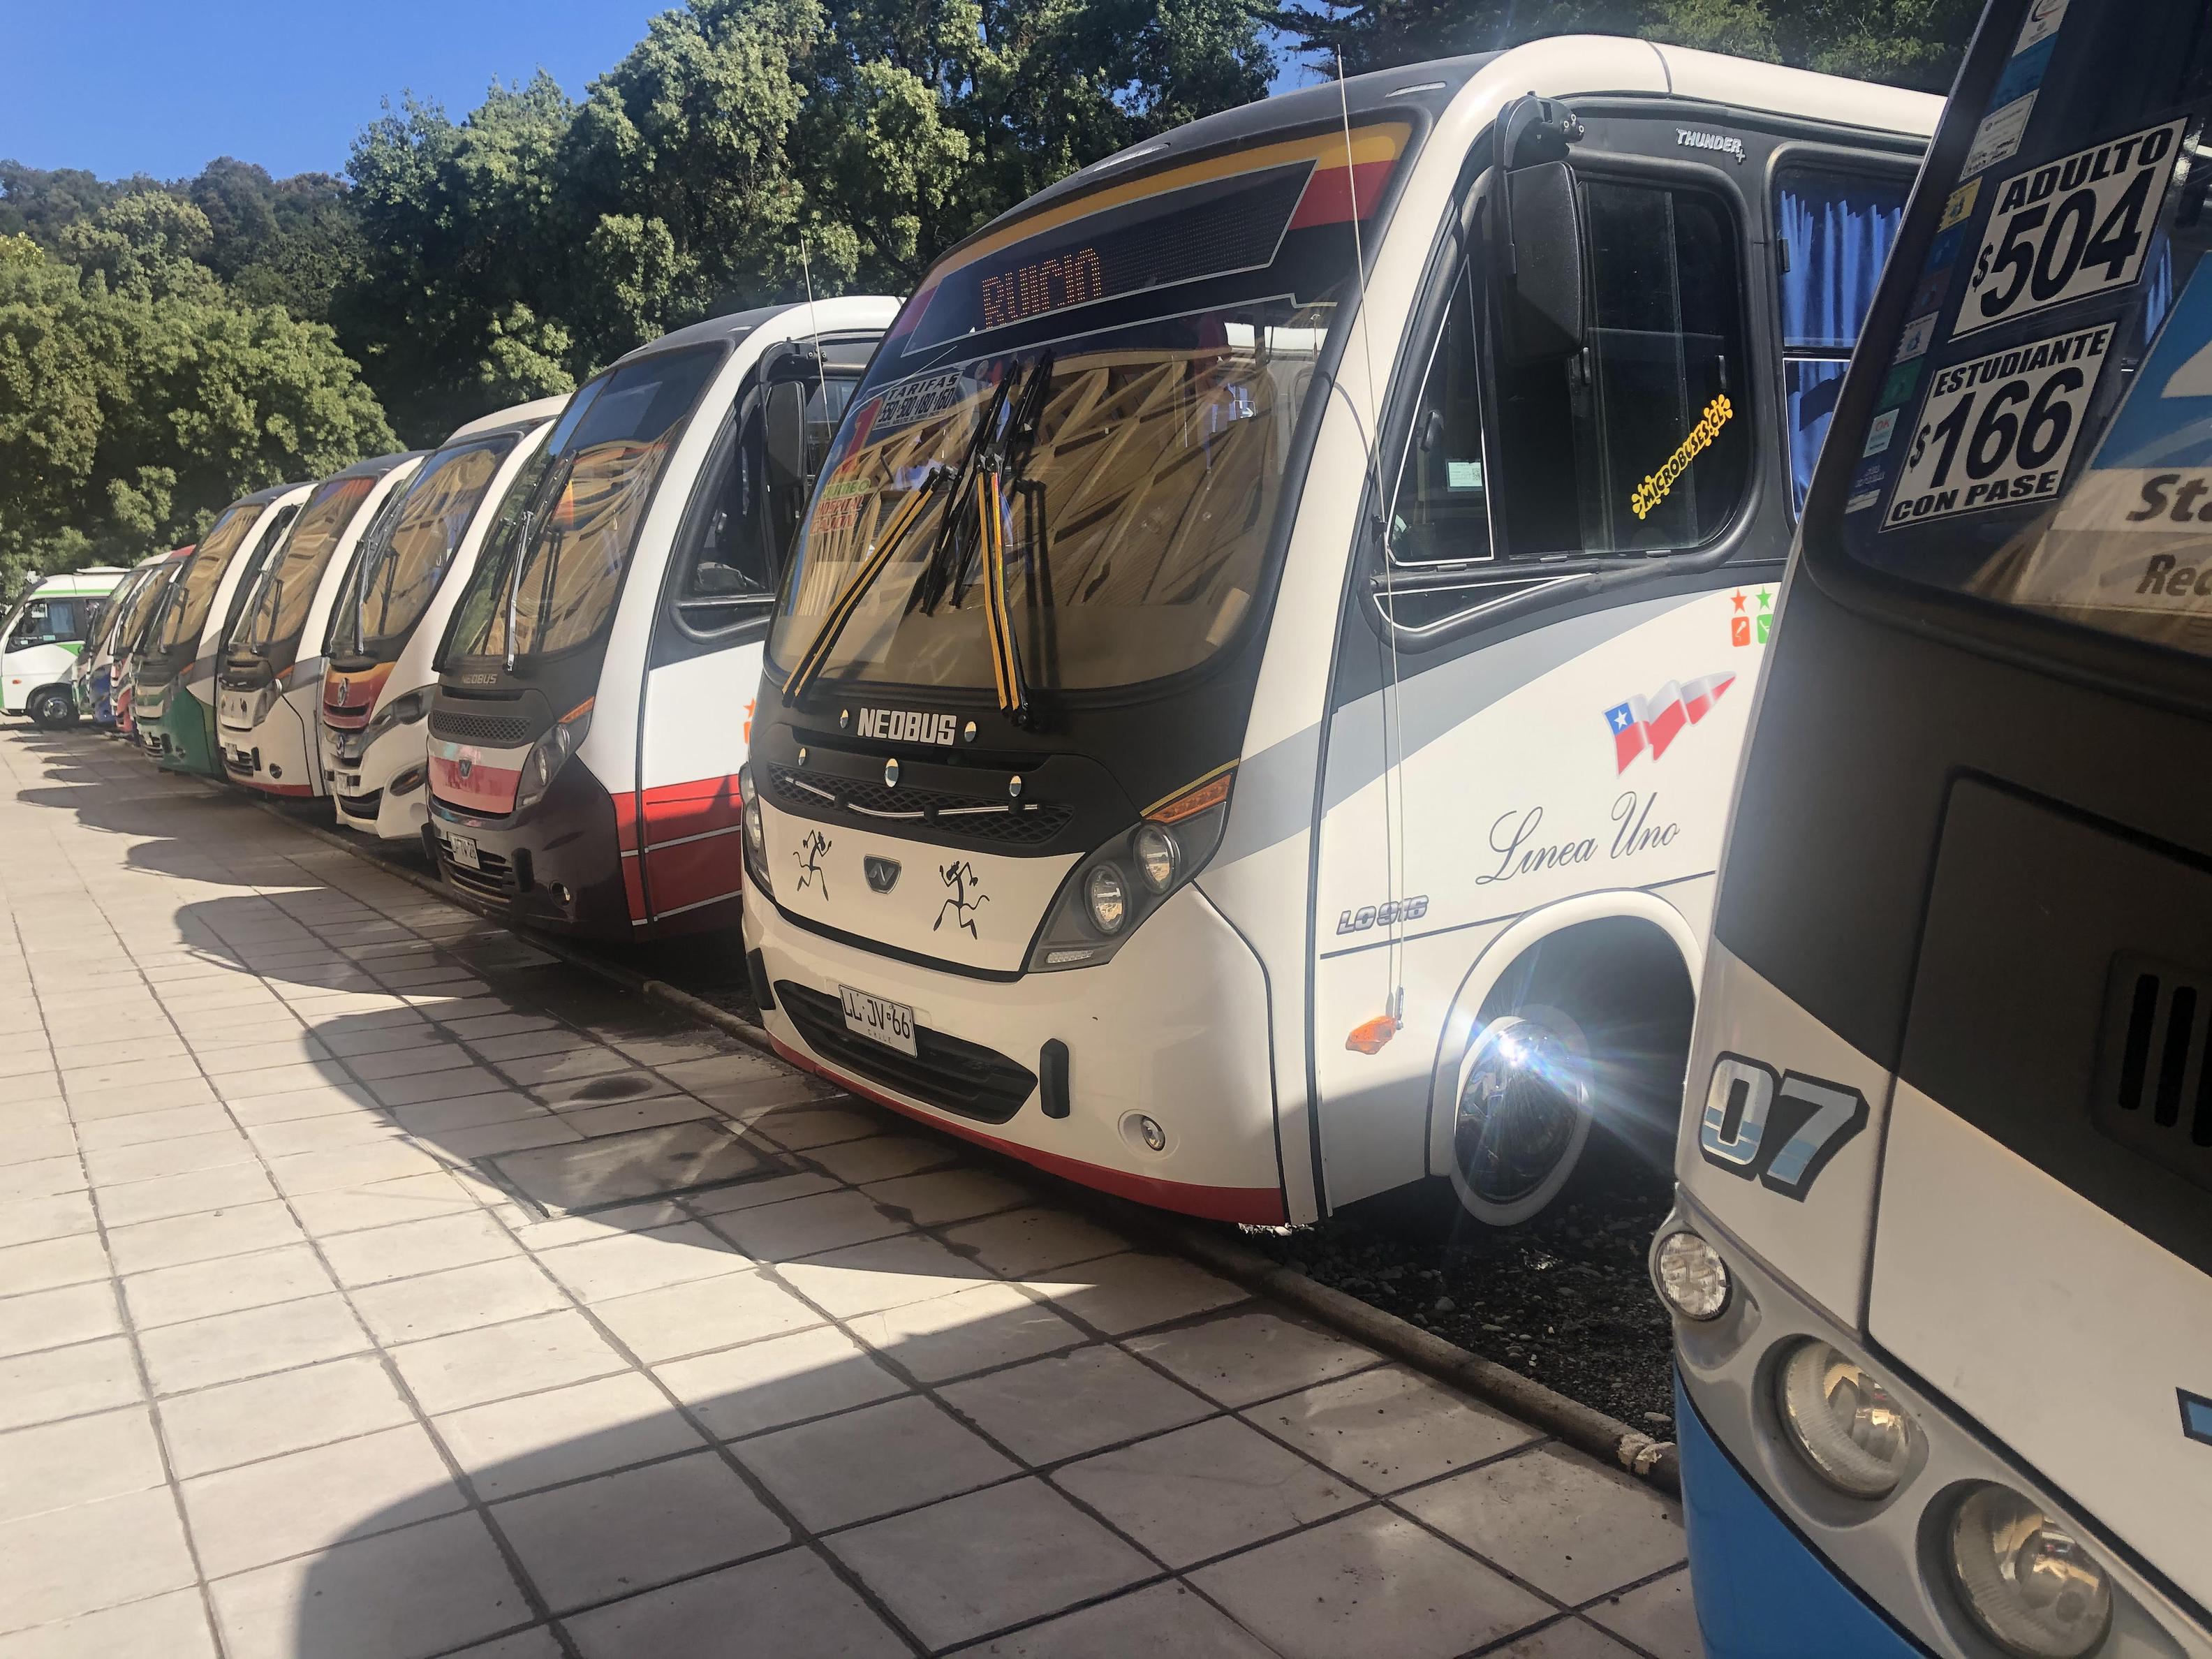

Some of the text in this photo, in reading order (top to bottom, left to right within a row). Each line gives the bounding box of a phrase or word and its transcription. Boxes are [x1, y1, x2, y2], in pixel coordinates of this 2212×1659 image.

[1998, 128, 2174, 216] ADULTO
[1972, 166, 2142, 318] $504
[889, 374, 960, 400] TARIFAS
[1933, 328, 2111, 399] ESTUDIANTE
[840, 397, 884, 475] 1
[1909, 366, 2084, 489] $166
[817, 494, 865, 517] HOSPITAL
[1891, 470, 2059, 522] CON PASE
[857, 707, 957, 746] NEOBUS
[1475, 791, 1681, 885] Linea Uno
[1699, 1051, 1871, 1204] 07
